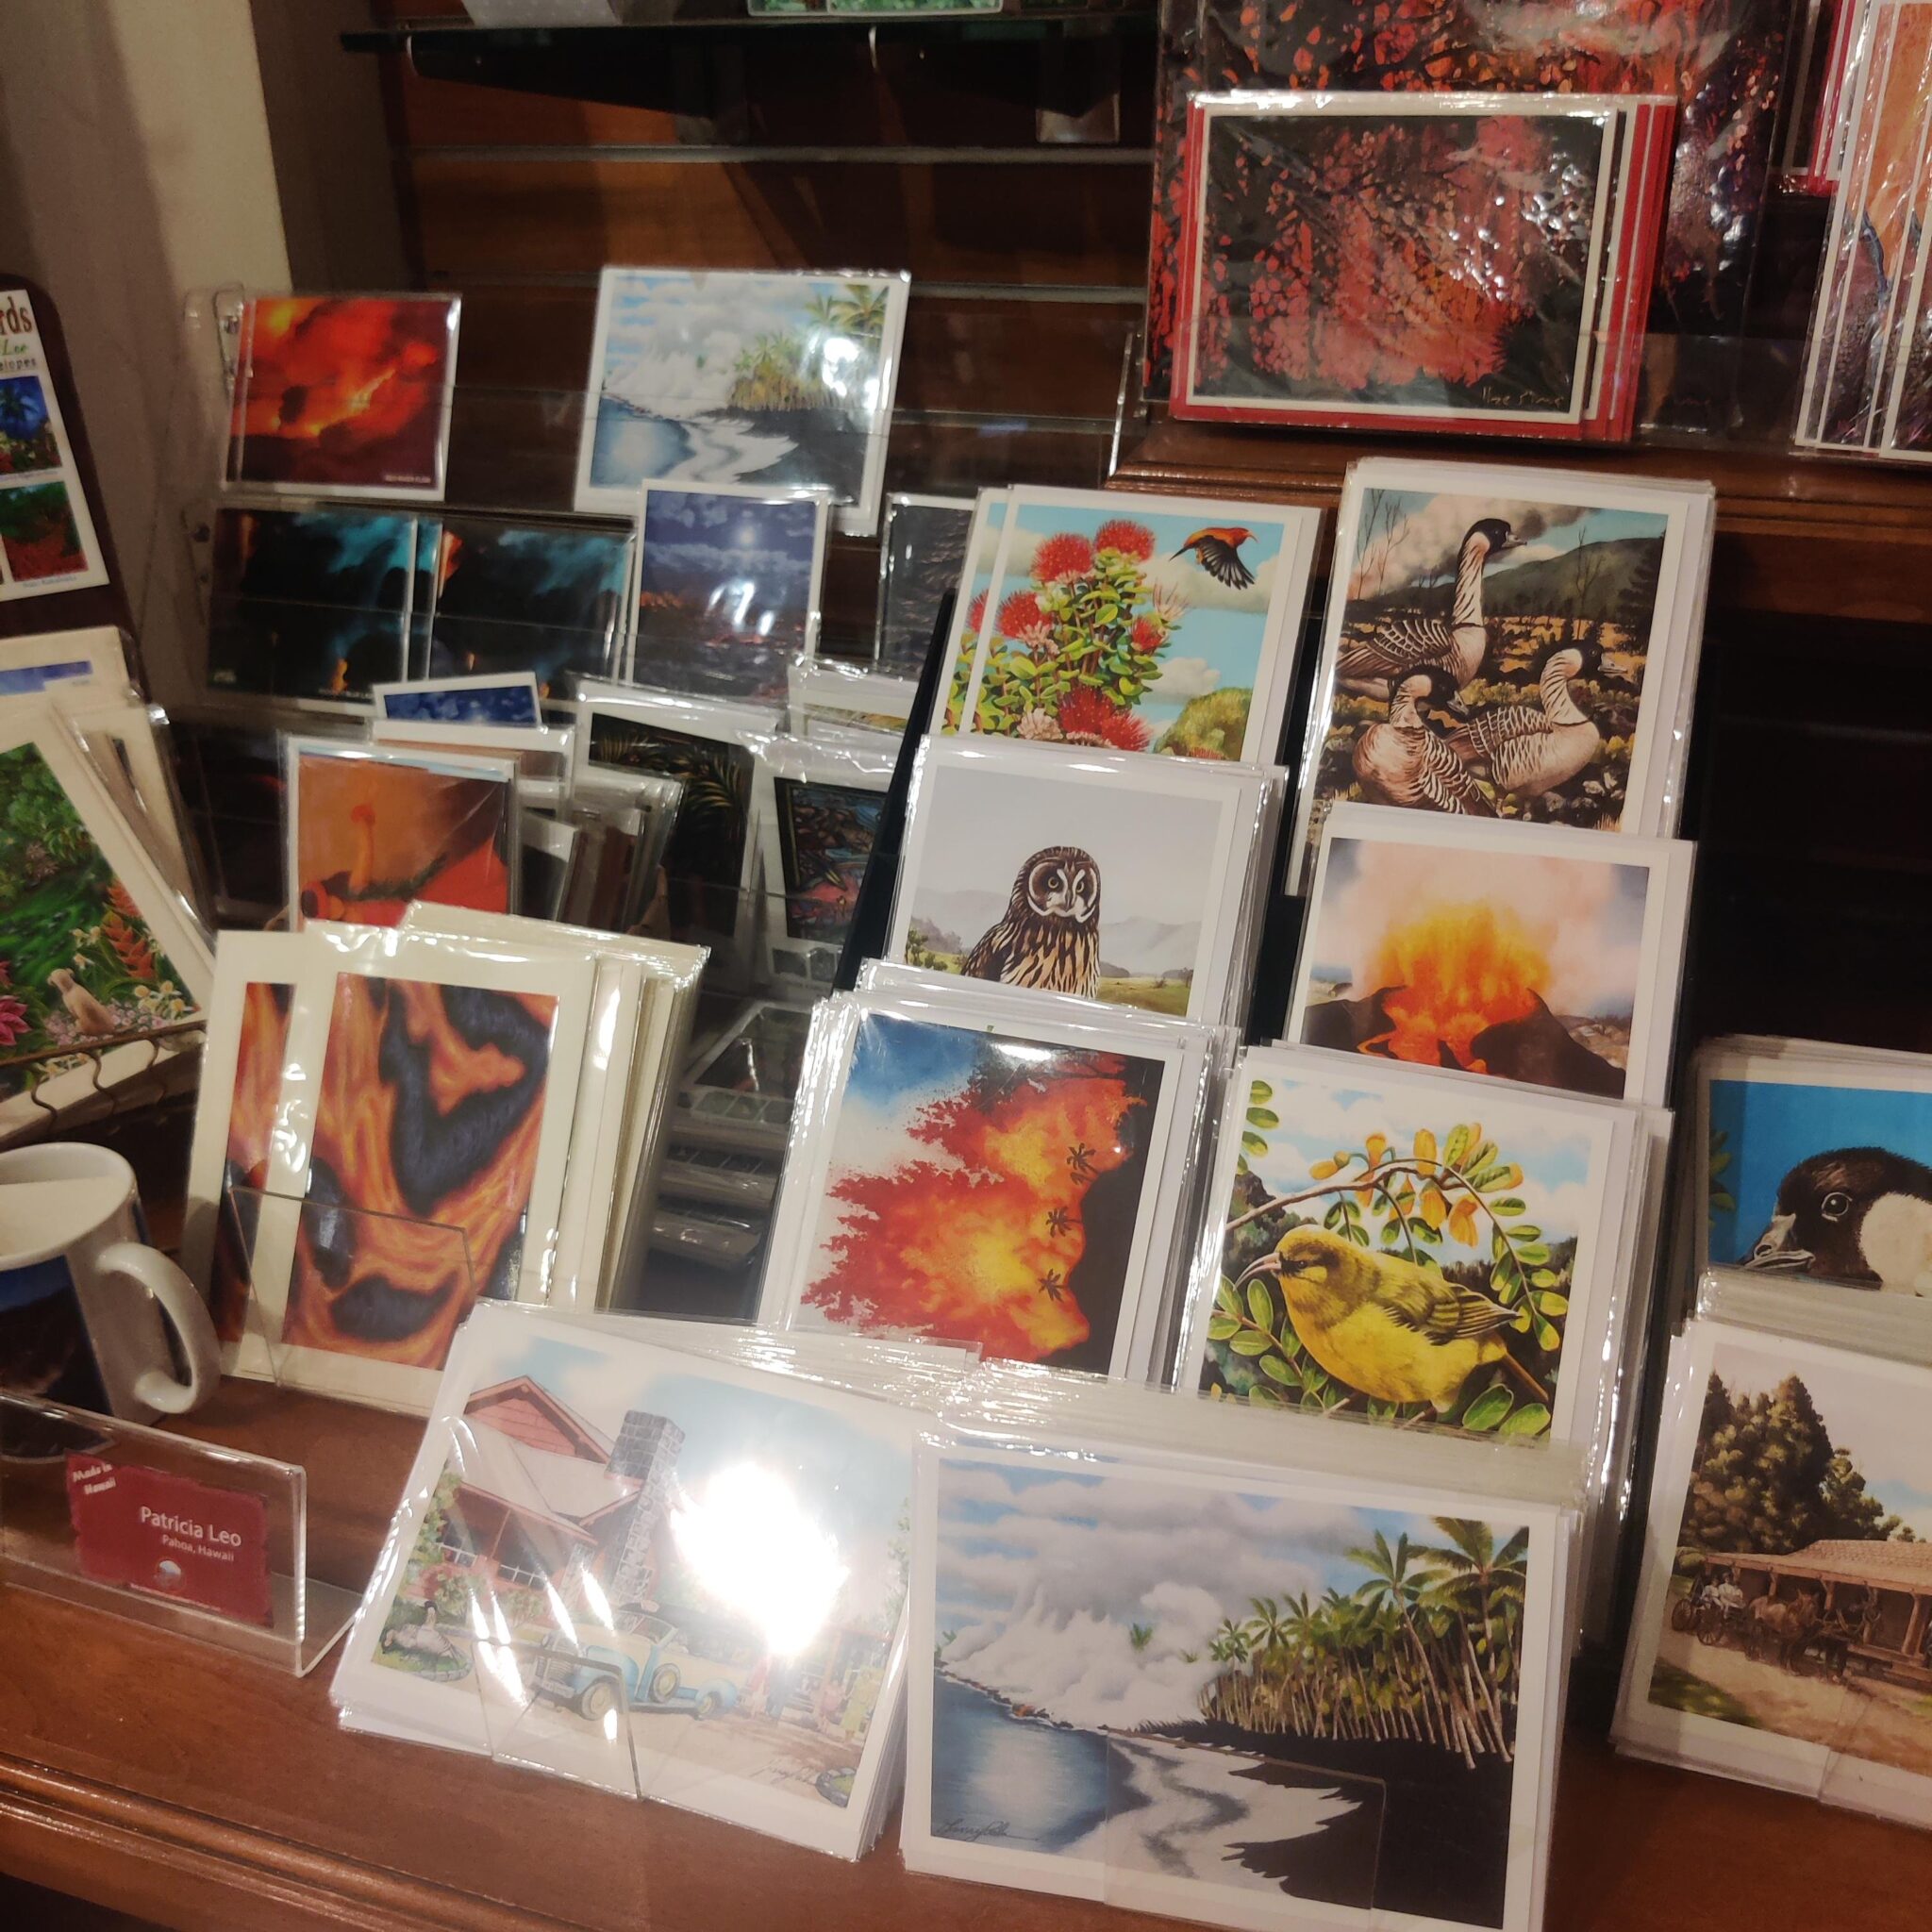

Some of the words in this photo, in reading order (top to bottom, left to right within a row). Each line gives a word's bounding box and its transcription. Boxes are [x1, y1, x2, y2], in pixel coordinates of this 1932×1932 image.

[73, 1465, 102, 1482] Made
[84, 1476, 116, 1494] Hawaii
[141, 1506, 204, 1539] Patricia
[209, 1524, 242, 1547] Leo
[161, 1534, 196, 1555] Pahoa,
[198, 1544, 235, 1562] Hawaii
